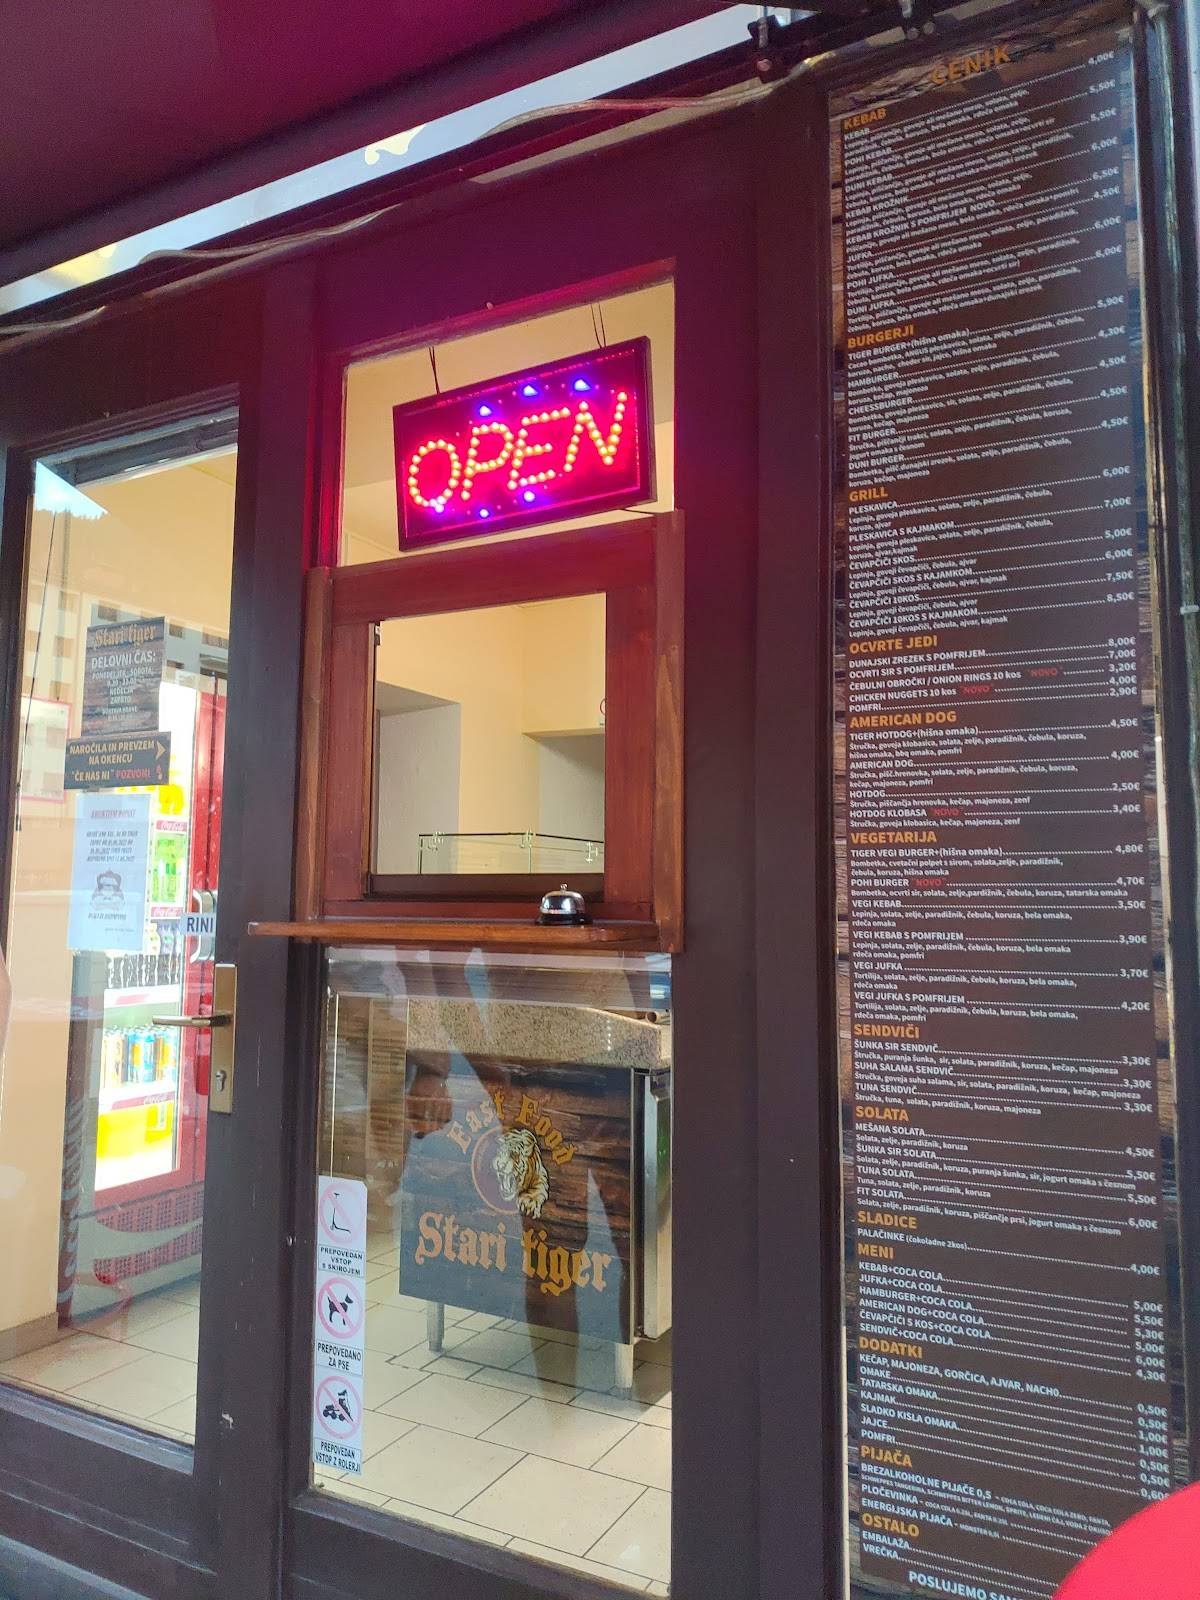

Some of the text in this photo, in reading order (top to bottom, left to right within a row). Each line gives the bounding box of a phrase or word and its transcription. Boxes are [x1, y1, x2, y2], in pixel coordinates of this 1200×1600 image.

[930, 43, 1011, 87] CENIK
[844, 107, 885, 130] KEBAB
[847, 324, 913, 349] BURGERJI
[408, 391, 628, 508] OPEN
[849, 465, 1130, 515] PLESKAVICA 6,00€
[849, 486, 888, 502] GRILL
[849, 569, 1133, 609] ČEVAPČIČI 10KOS 7,50€
[849, 634, 937, 655] OCVRTE JEDI
[849, 656, 890, 669] DUNAJSKI
[892, 653, 924, 665] ZREZEK
[934, 647, 985, 661] POMFRIJEM
[1108, 635, 1135, 648] 8,00€
[92, 651, 156, 668] DELOVNI ČAS:
[849, 679, 885, 693] ČEBULNI
[887, 676, 926, 689] OBROČKI
[932, 673, 962, 686] ONION
[964, 670, 991, 683] RINGS
[1108, 661, 1135, 673] 3,20€
[849, 692, 885, 704] CHICKEN
[887, 689, 927, 700] NUGGETS
[1109, 674, 1136, 687] 4,00€
[849, 686, 1136, 713] POMFRI 2,90€
[850, 709, 956, 729] AMERICAN DOG
[69, 740, 154, 754] NAROČILA IN PREVZEM
[88, 753, 133, 766] NA OKENCU
[85, 769, 100, 782] NAS
[849, 782, 1139, 798] HOTDOG 2,50€
[850, 830, 936, 845] VEGETARIJA
[852, 899, 1145, 910] VEGI KEBAB 3,50€
[186, 917, 214, 933] RINI
[854, 1021, 919, 1038] SENDVIČI
[855, 1040, 1150, 1066] ŠUNKA SIR SENDVIČ 3,30€
[856, 1082, 1152, 1113] TUNA SENDVIČ 3,30€
[856, 1105, 908, 1121] SOLATA
[515, 1093, 579, 1165] Food
[856, 1121, 1154, 1158] MEŠANA SOLATA 4,50€
[857, 1211, 917, 1230] SLADICE
[320, 1246, 363, 1261] PREPOVEDAN
[330, 1255, 352, 1266] VSTOP
[414, 1211, 612, 1297] Stari tiger
[857, 1227, 904, 1242] PALAČINKE
[1130, 1263, 1159, 1277] 4,00€
[858, 1243, 893, 1259] MENI
[327, 1263, 361, 1276] SKIROJEM
[947, 1298, 972, 1311] COLA
[1134, 1327, 1164, 1342] 5,30€
[317, 1341, 362, 1363] PREPOVEDANO
[859, 1336, 922, 1358] DODATKI
[929, 1331, 953, 1346] COLA
[1136, 1368, 1165, 1383] 4,30€
[328, 1357, 350, 1371] ZA PSE
[860, 1353, 889, 1368] KEČAP,
[891, 1358, 942, 1378] MAJONEZA,
[944, 1368, 988, 1386] GORČICA,
[990, 1376, 1023, 1392] AJVAR,
[1137, 1403, 1167, 1418] 0,50€
[860, 1366, 1167, 1432] OMAKE 0,50€
[861, 1428, 895, 1444] POMFRI
[315, 1453, 333, 1466] VSTOP
[320, 1440, 356, 1459] PREPOVEDAN
[861, 1416, 1169, 1489] JAJCE 0,50€
[861, 1443, 911, 1467] PIJAČA
[861, 1463, 991, 1500] BREZALKOHOLNE PIJAČE 0,5
[861, 1483, 917, 1505] PLOČEVINKA
[861, 1497, 917, 1519] ENERGIJSKA
[920, 1509, 952, 1527] PIJAČA
[862, 1511, 919, 1538] OSTALO
[862, 1530, 909, 1550] EMBALAŽA
[863, 1542, 898, 1560] VREČKA
[909, 1570, 985, 1600] POSLUJEMO
